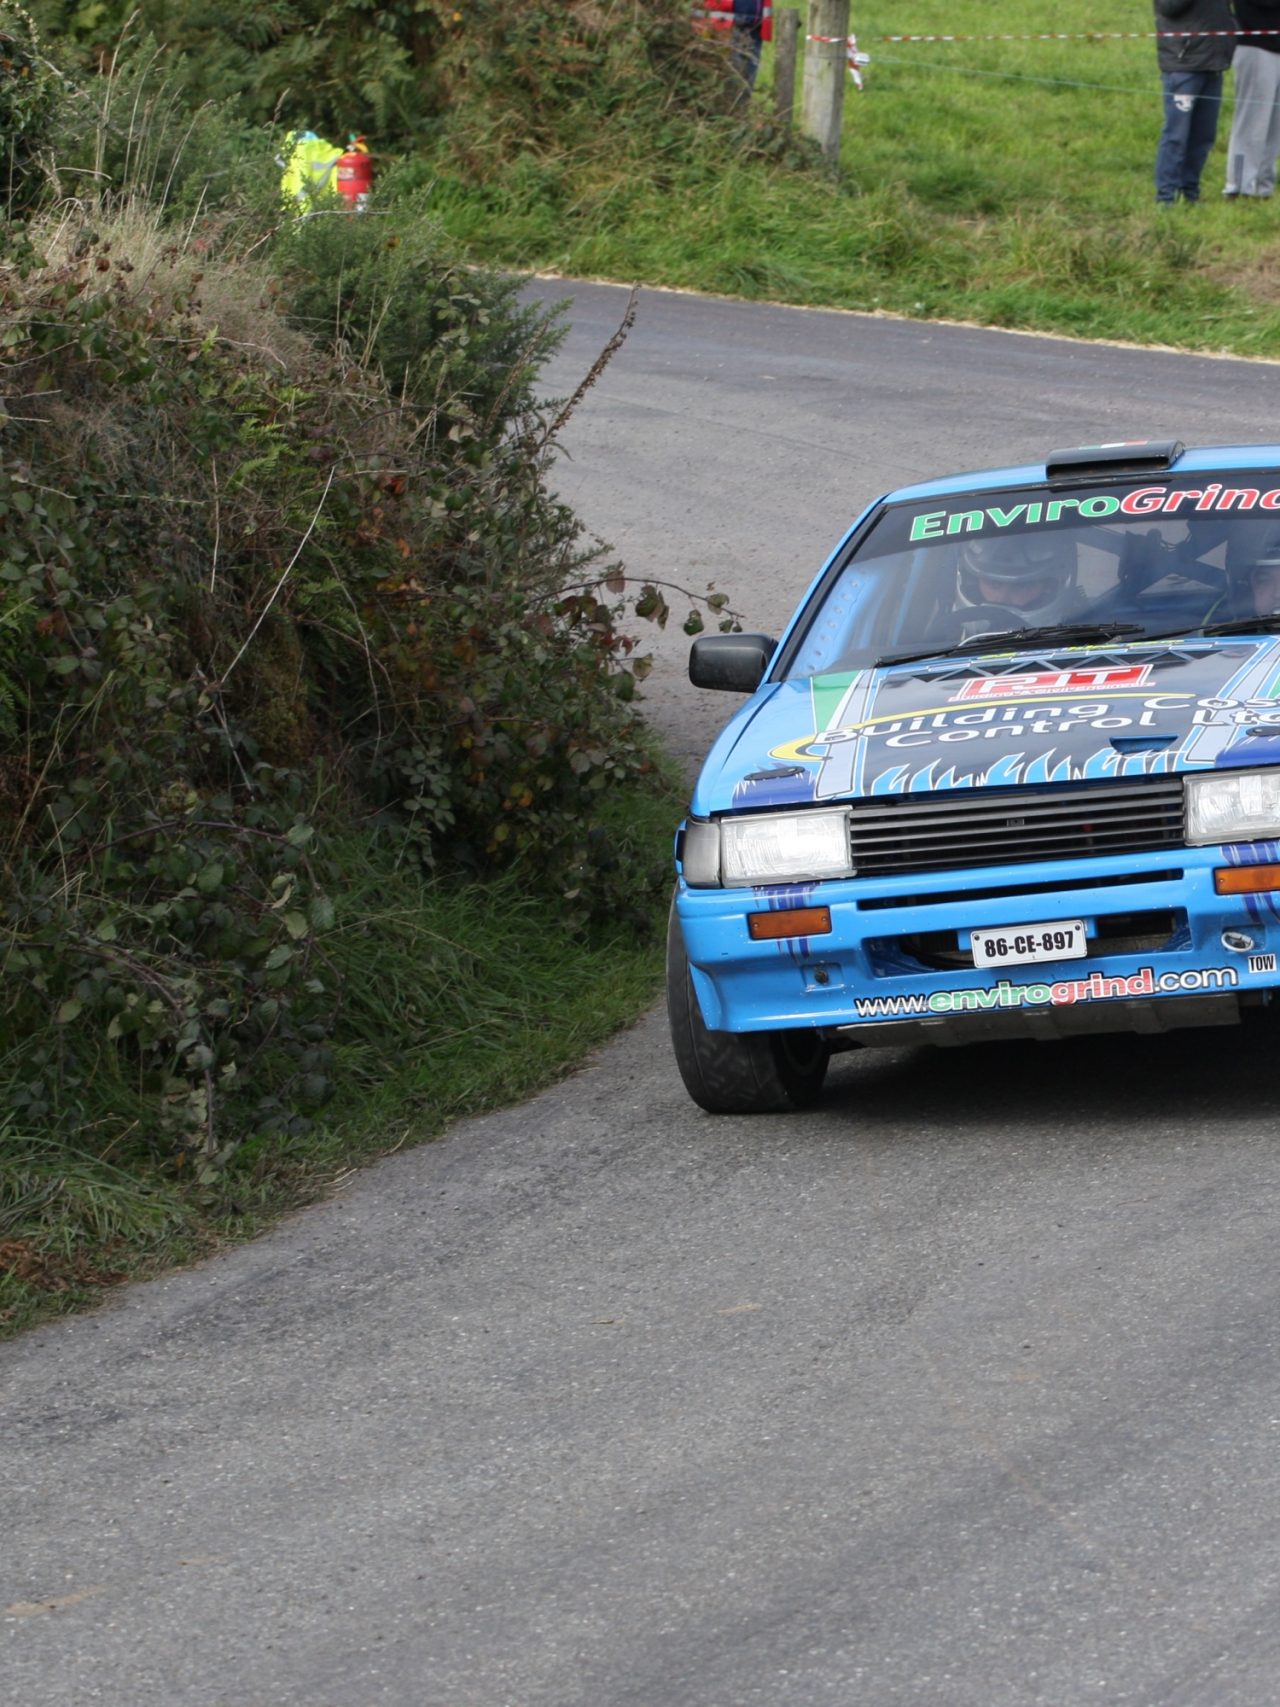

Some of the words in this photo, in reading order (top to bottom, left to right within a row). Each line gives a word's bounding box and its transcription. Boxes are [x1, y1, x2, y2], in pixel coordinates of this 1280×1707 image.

[814, 702, 1108, 745] Building
[885, 710, 1156, 747] Control
[984, 930, 1075, 957] 86-CE-897
[1249, 955, 1275, 972] TOW
[855, 967, 1238, 1018] www.envirogrind.com
